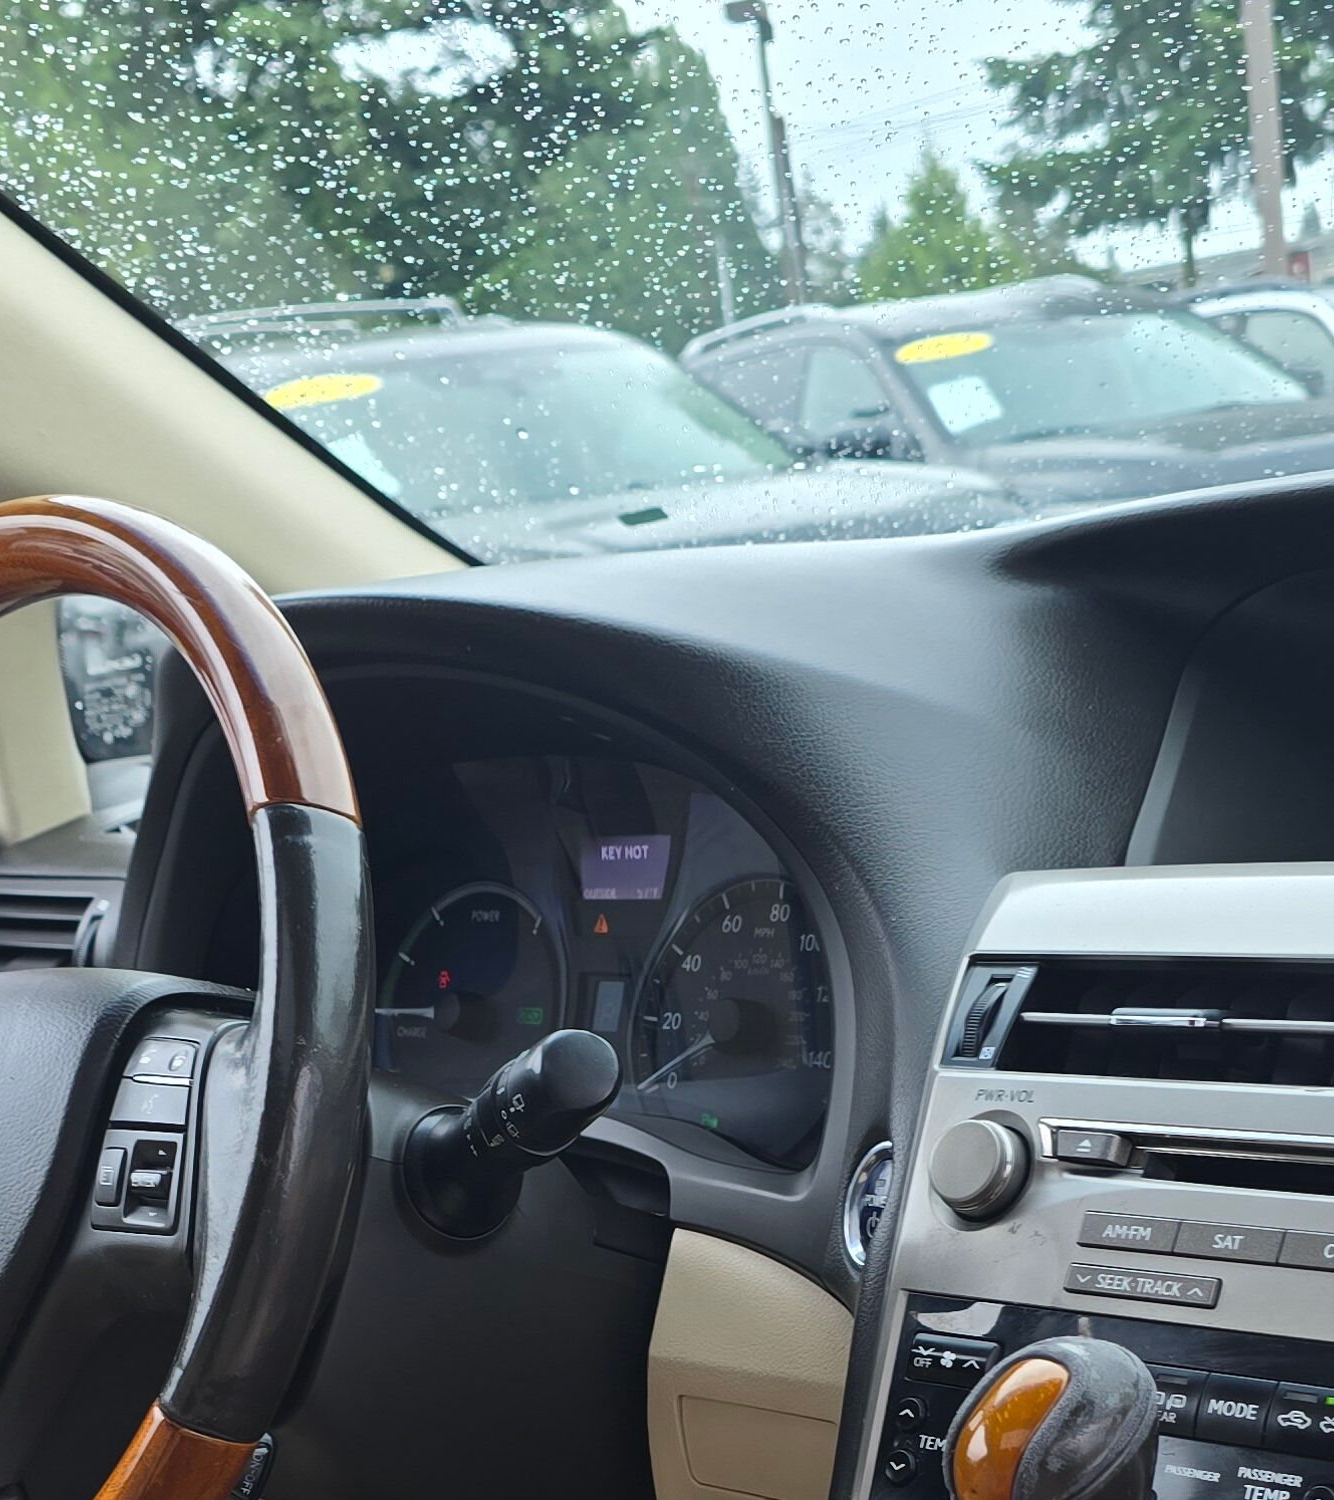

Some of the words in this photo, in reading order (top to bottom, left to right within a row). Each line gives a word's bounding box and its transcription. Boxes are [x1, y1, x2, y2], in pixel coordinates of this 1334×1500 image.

[601, 845, 622, 860] KEY
[624, 844, 649, 859] NOT
[769, 904, 790, 922] 80
[721, 915, 742, 933] 60
[754, 927, 775, 938] MPH
[681, 954, 702, 973] 40
[662, 1012, 682, 1030] 20
[667, 1072, 678, 1089] 0
[1212, 1233, 1245, 1250] SAT
[913, 1357, 934, 1368] OFF
[1207, 1399, 1260, 1421] MODE
[918, 1434, 948, 1453] TEM
[1164, 1464, 1221, 1483] PASSENGER
[1237, 1466, 1304, 1488] PASSENGER
